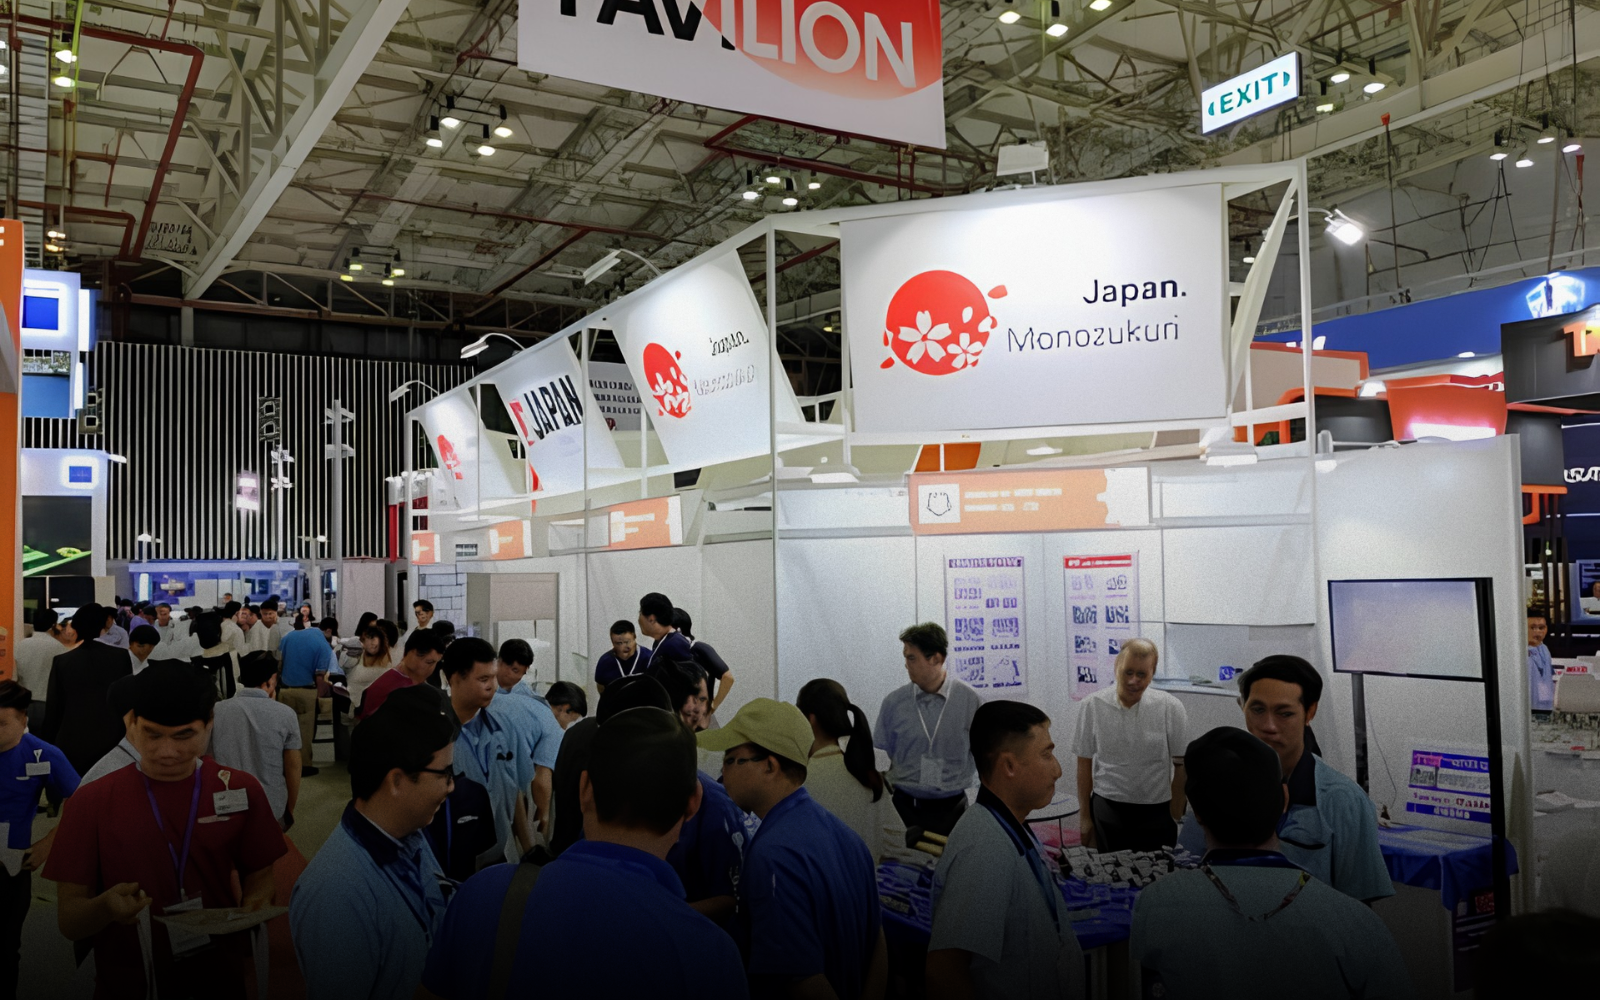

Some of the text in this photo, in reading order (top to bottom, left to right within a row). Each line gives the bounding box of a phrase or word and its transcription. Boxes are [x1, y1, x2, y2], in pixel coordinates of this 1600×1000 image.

[560, 0, 917, 88] AVILION
[1220, 72, 1278, 114] EXIT
[1083, 279, 1187, 307] Japan.
[1008, 315, 1179, 352] Monozukuri
[524, 374, 584, 440] JAPAN
